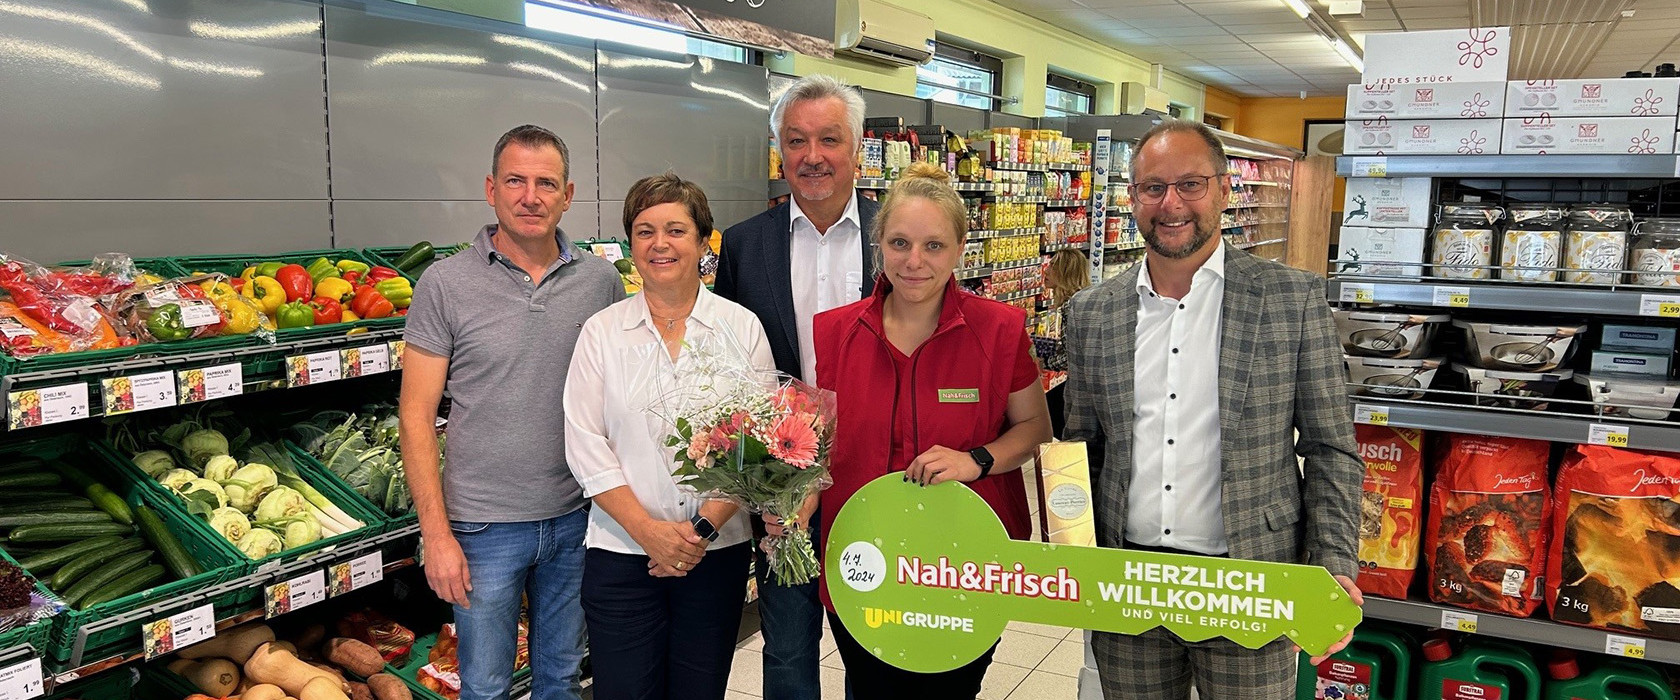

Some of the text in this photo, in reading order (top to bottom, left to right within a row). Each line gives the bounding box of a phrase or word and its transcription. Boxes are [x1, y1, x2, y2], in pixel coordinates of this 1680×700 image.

[1375, 75, 1453, 85] JEDES STÜCK
[1663, 306, 1680, 314] 2,99
[1607, 436, 1627, 444] 19,99
[1493, 473, 1532, 489] Jeden Tag
[1630, 468, 1668, 492] Jeden
[847, 568, 876, 583] 2024
[897, 555, 1080, 601] Nah&Frisch
[1124, 560, 1266, 593] HERZLICH
[1440, 578, 1463, 593] 3 kg
[1097, 581, 1294, 621] WILLKOMMEN
[1561, 596, 1590, 612] 3 kg
[174, 615, 193, 624] GURKEN
[864, 607, 974, 633] UNIGRUPPE
[1122, 608, 1267, 633] UND VIEL ERFOLG!
[1628, 648, 1644, 656] 4,99
